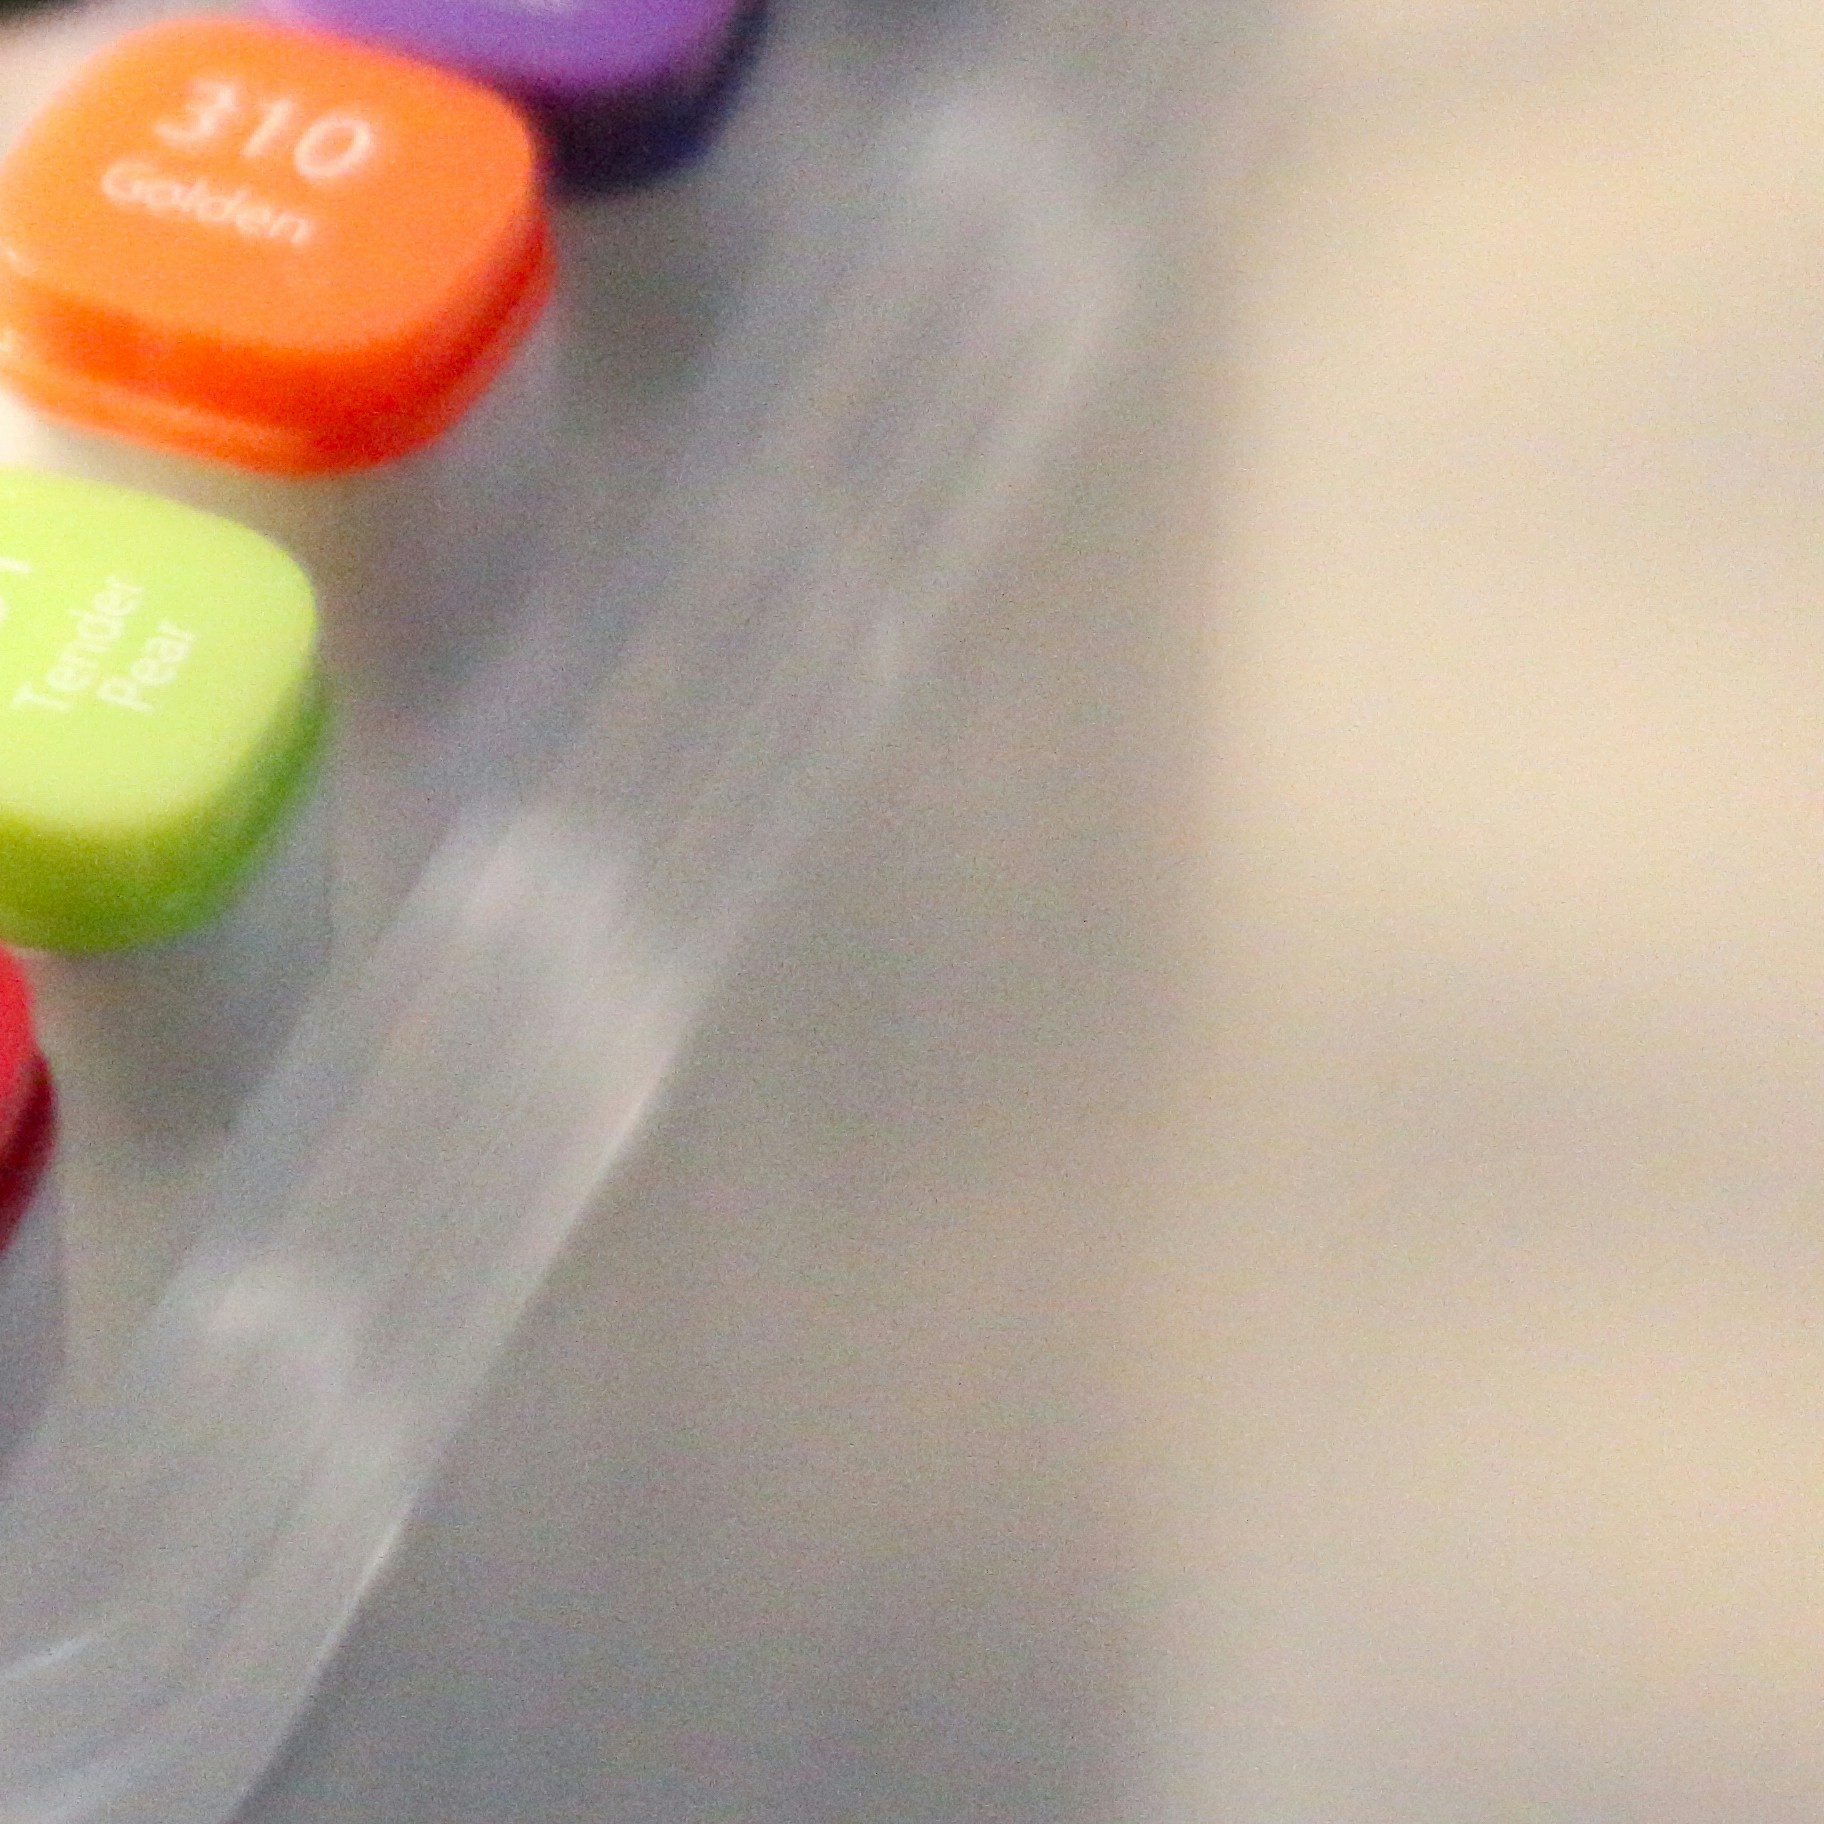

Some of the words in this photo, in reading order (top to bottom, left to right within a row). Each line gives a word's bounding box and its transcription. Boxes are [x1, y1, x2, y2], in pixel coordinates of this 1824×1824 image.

[151, 75, 380, 181] 310
[100, 158, 319, 249] Golden
[13, 569, 143, 715] Tender
[98, 614, 202, 715] Pear
